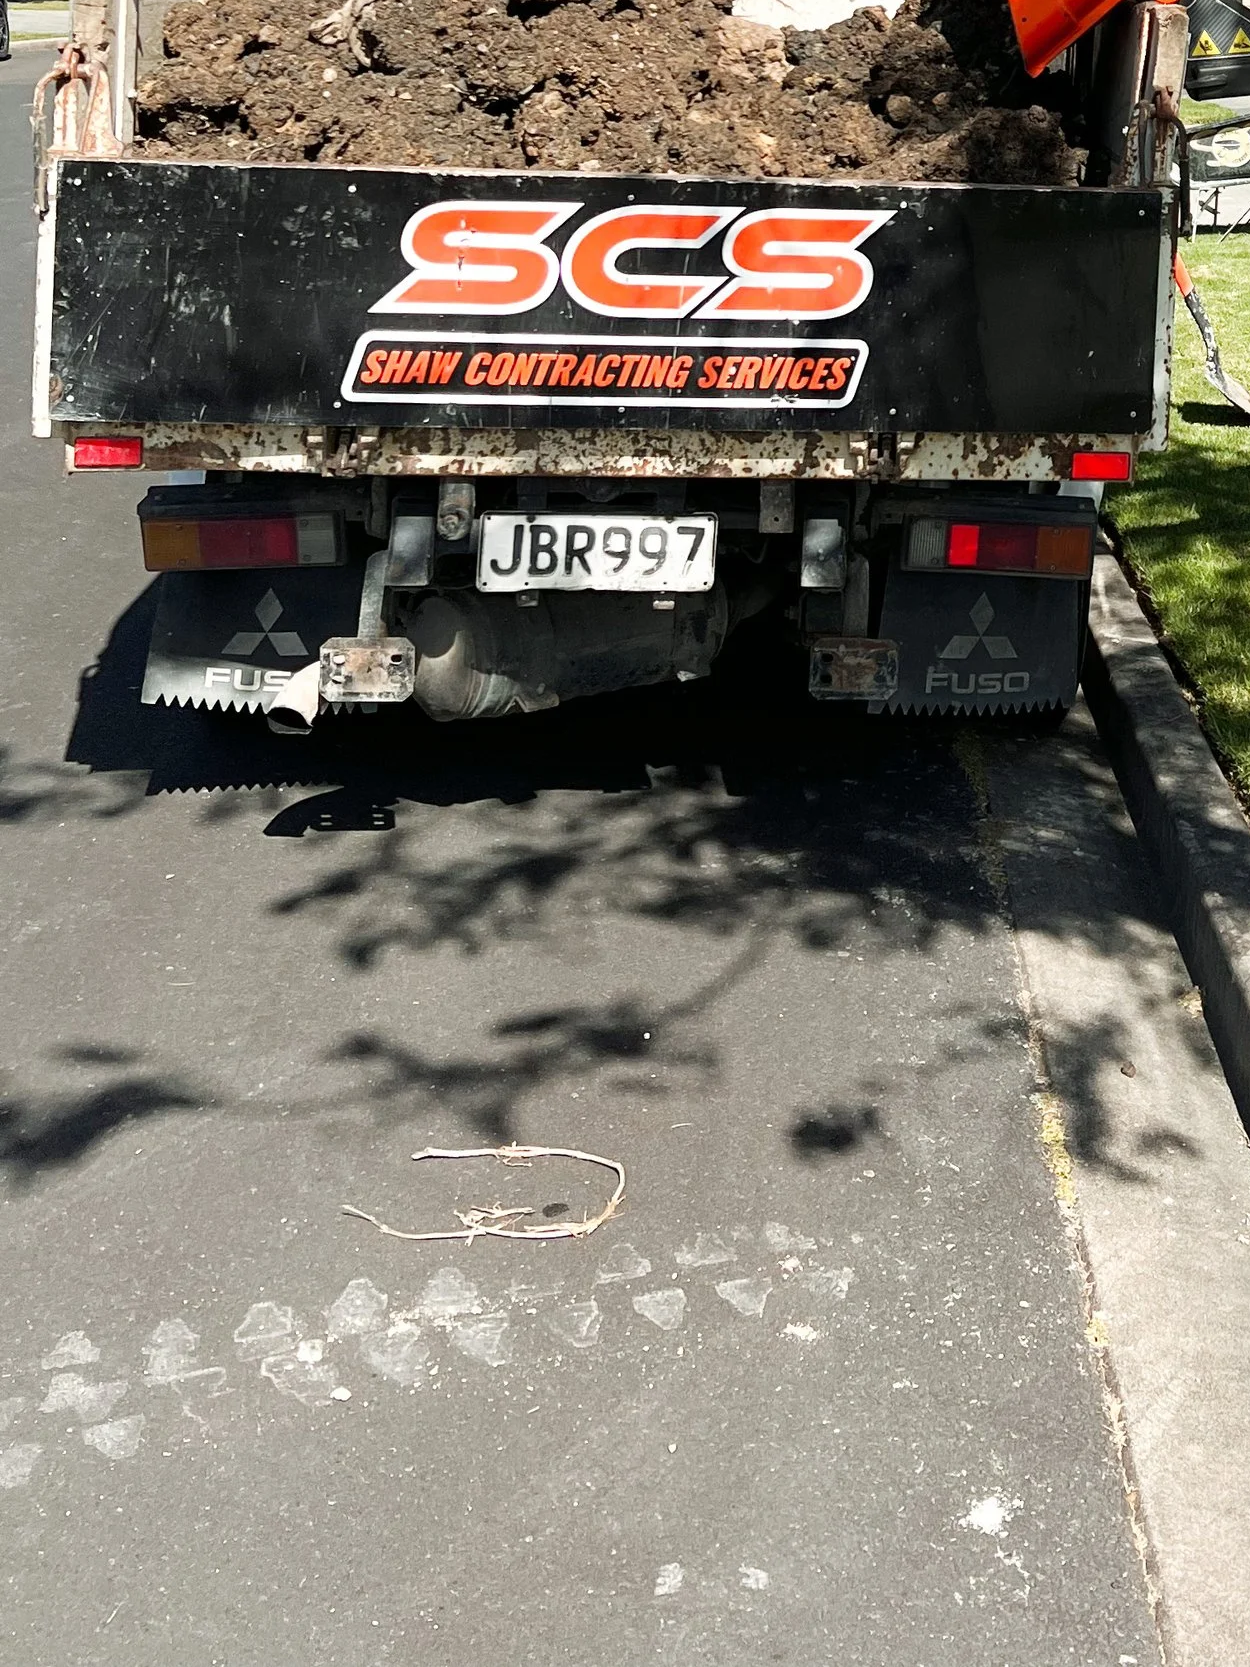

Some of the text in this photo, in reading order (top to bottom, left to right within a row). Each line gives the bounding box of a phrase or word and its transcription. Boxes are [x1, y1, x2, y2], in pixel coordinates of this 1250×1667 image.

[366, 200, 898, 321] SCS
[360, 349, 853, 391] SHAW CONTRACTING SERVICES
[490, 524, 706, 576] JBR997
[204, 666, 292, 692] FUS
[925, 669, 1030, 694] FUSO
